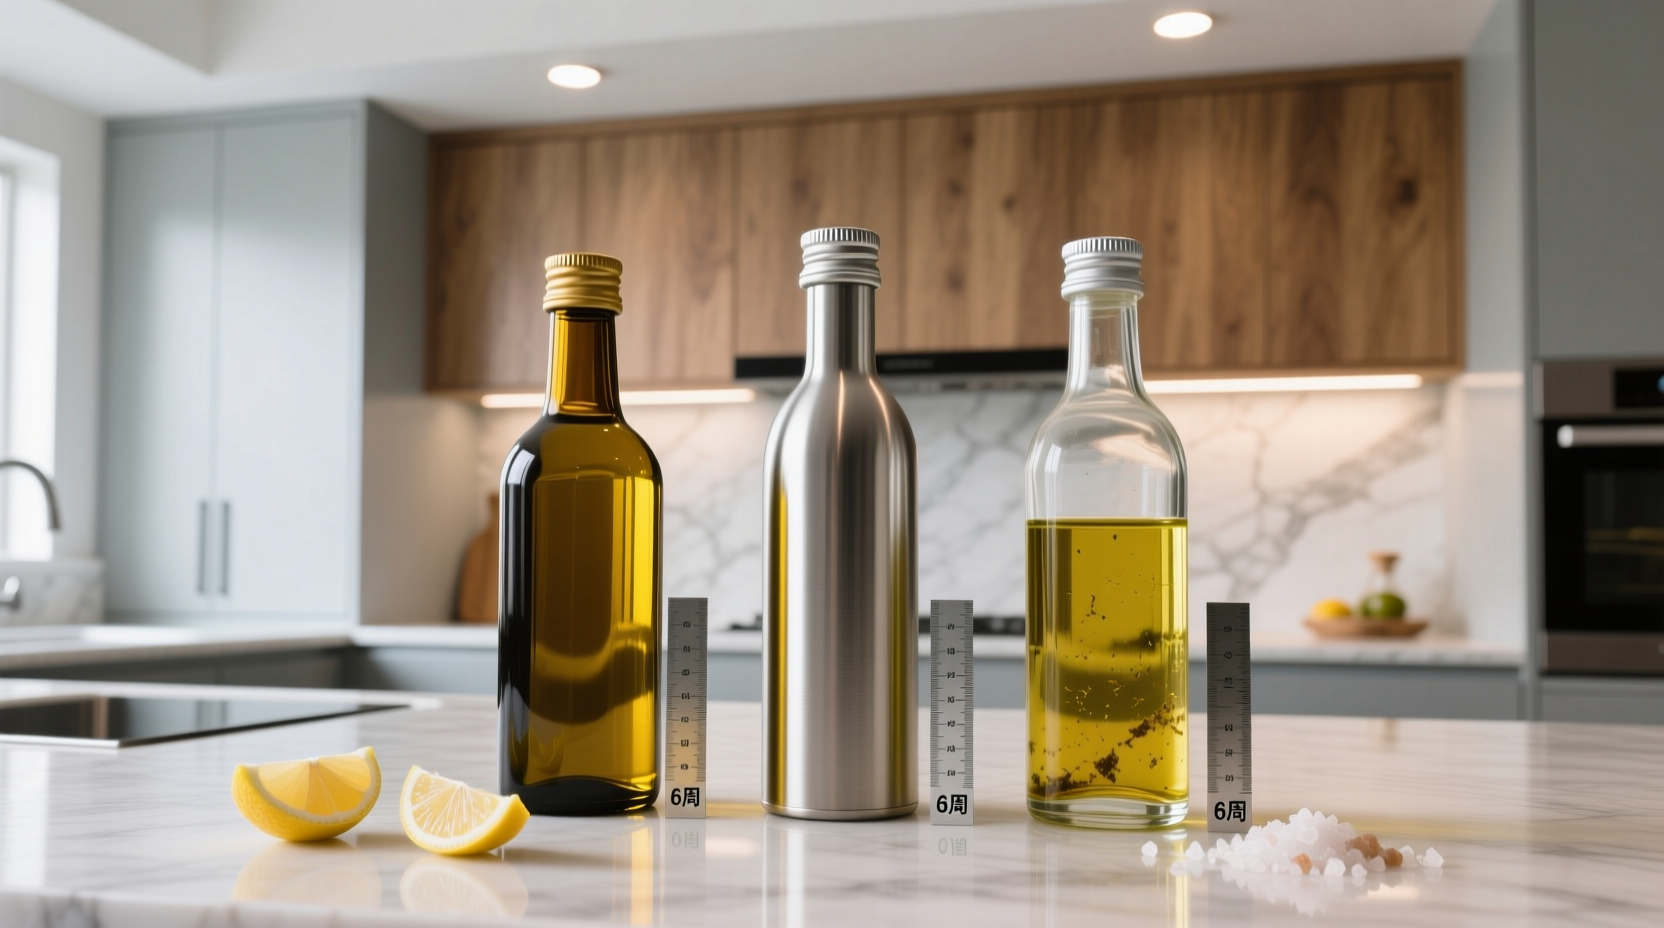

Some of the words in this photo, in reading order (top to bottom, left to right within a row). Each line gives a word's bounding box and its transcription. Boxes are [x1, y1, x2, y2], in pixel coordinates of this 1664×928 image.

[670, 787, 700, 808] 6周
[936, 794, 968, 814] 6周
[1213, 800, 1247, 823] 6周
